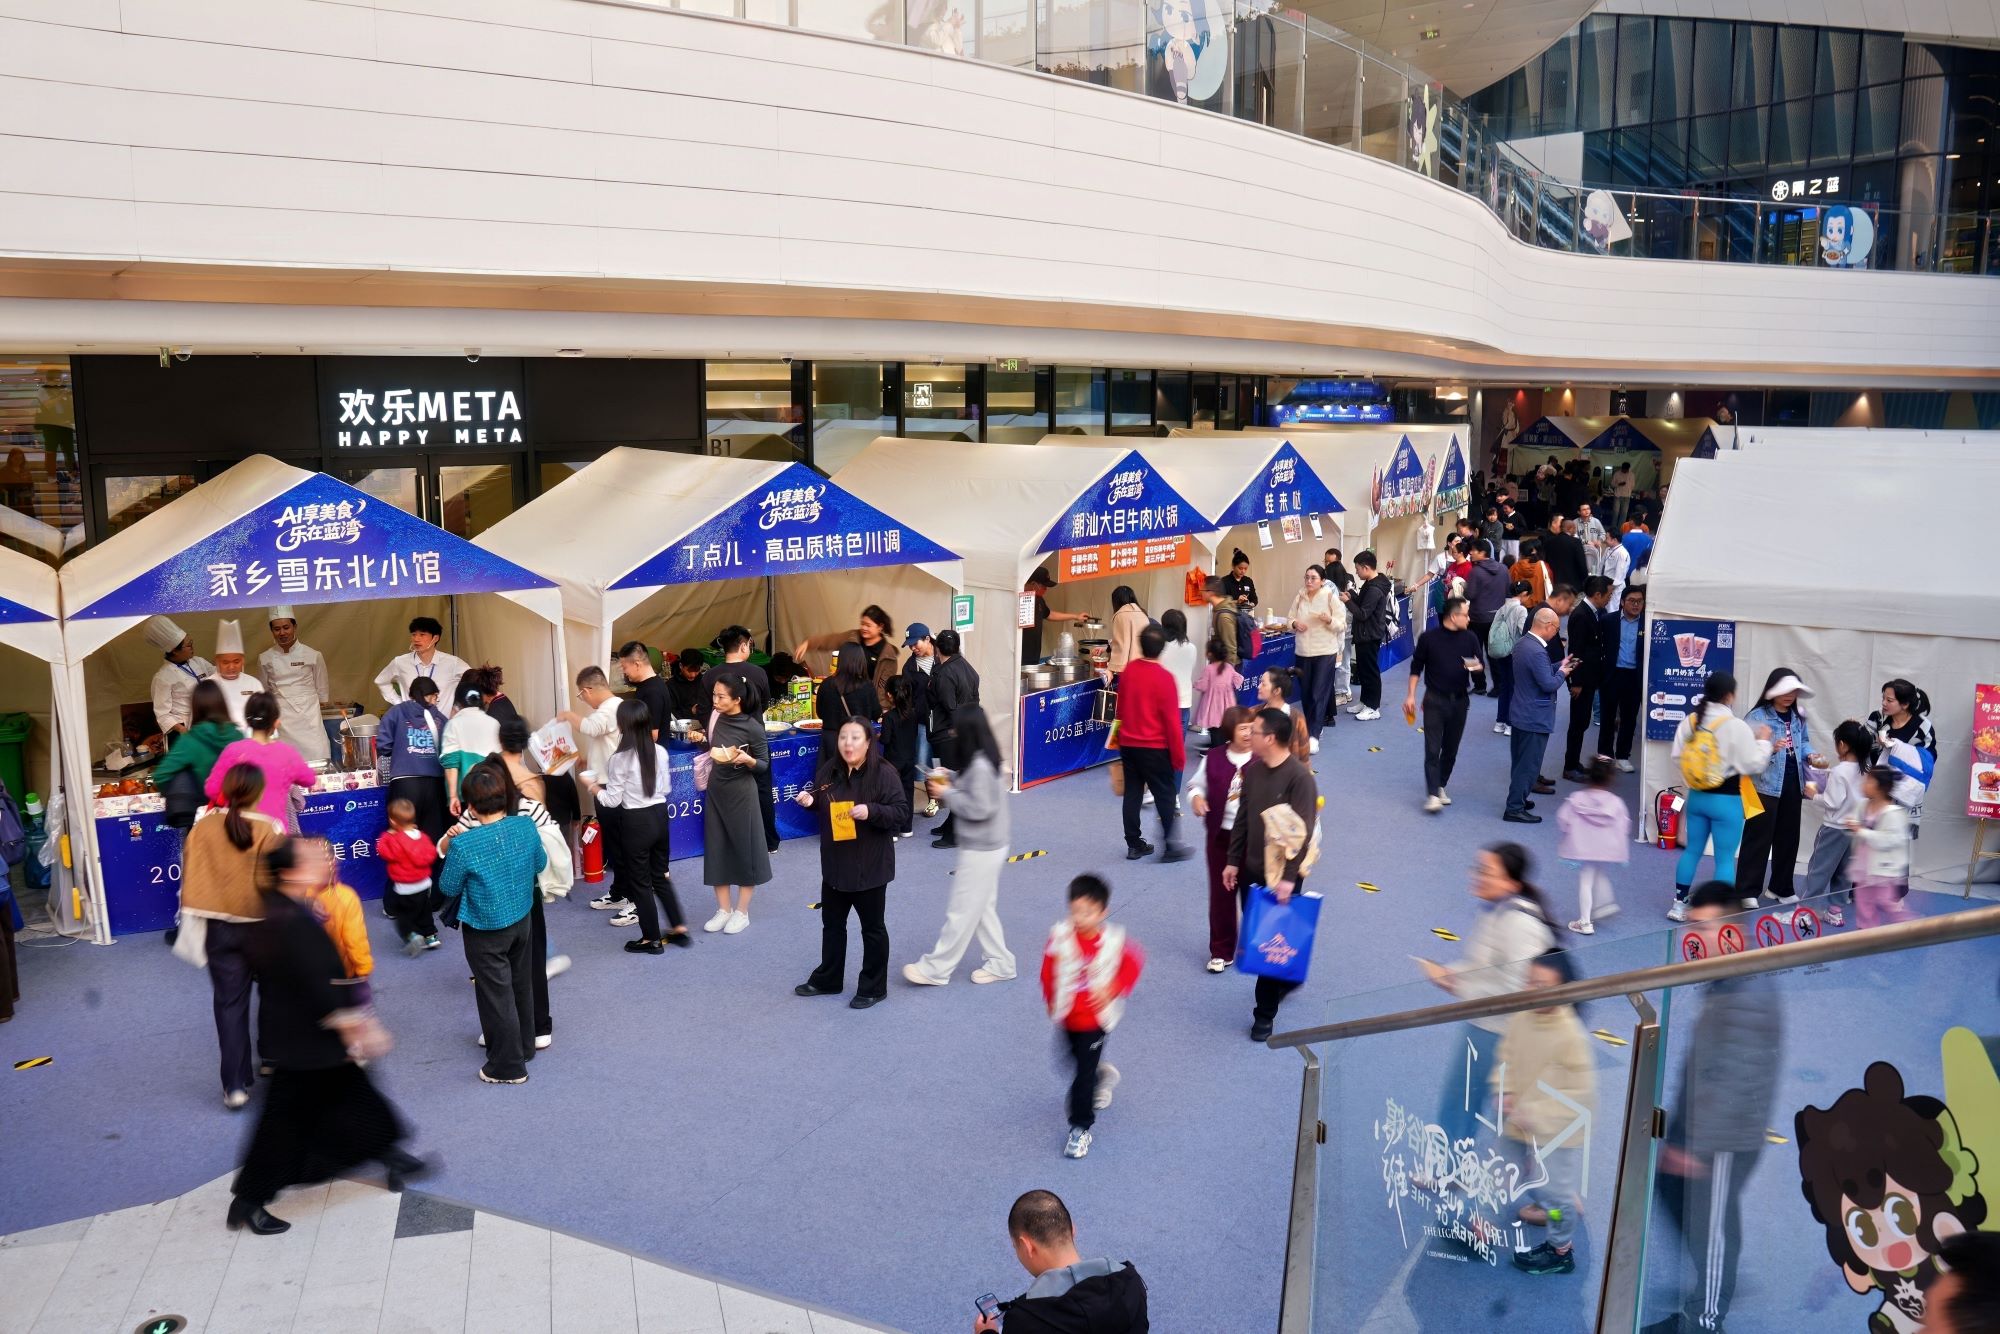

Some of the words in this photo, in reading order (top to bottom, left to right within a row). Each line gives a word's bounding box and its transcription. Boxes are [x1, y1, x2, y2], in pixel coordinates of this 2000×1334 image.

[338, 388, 522, 426] 欢乐META
[338, 429, 429, 447] HAPPY
[455, 428, 522, 444] META
[710, 438, 732, 457] B1
[759, 484, 820, 510] AI享美食
[272, 499, 358, 528] AI享美食
[759, 502, 823, 529] 乐在蓝湾
[1072, 504, 1178, 539] 潮汕大目牛肉火锅
[276, 518, 366, 551] 乐在蓝湾
[206, 551, 442, 597] 家乡雪东北小馆
